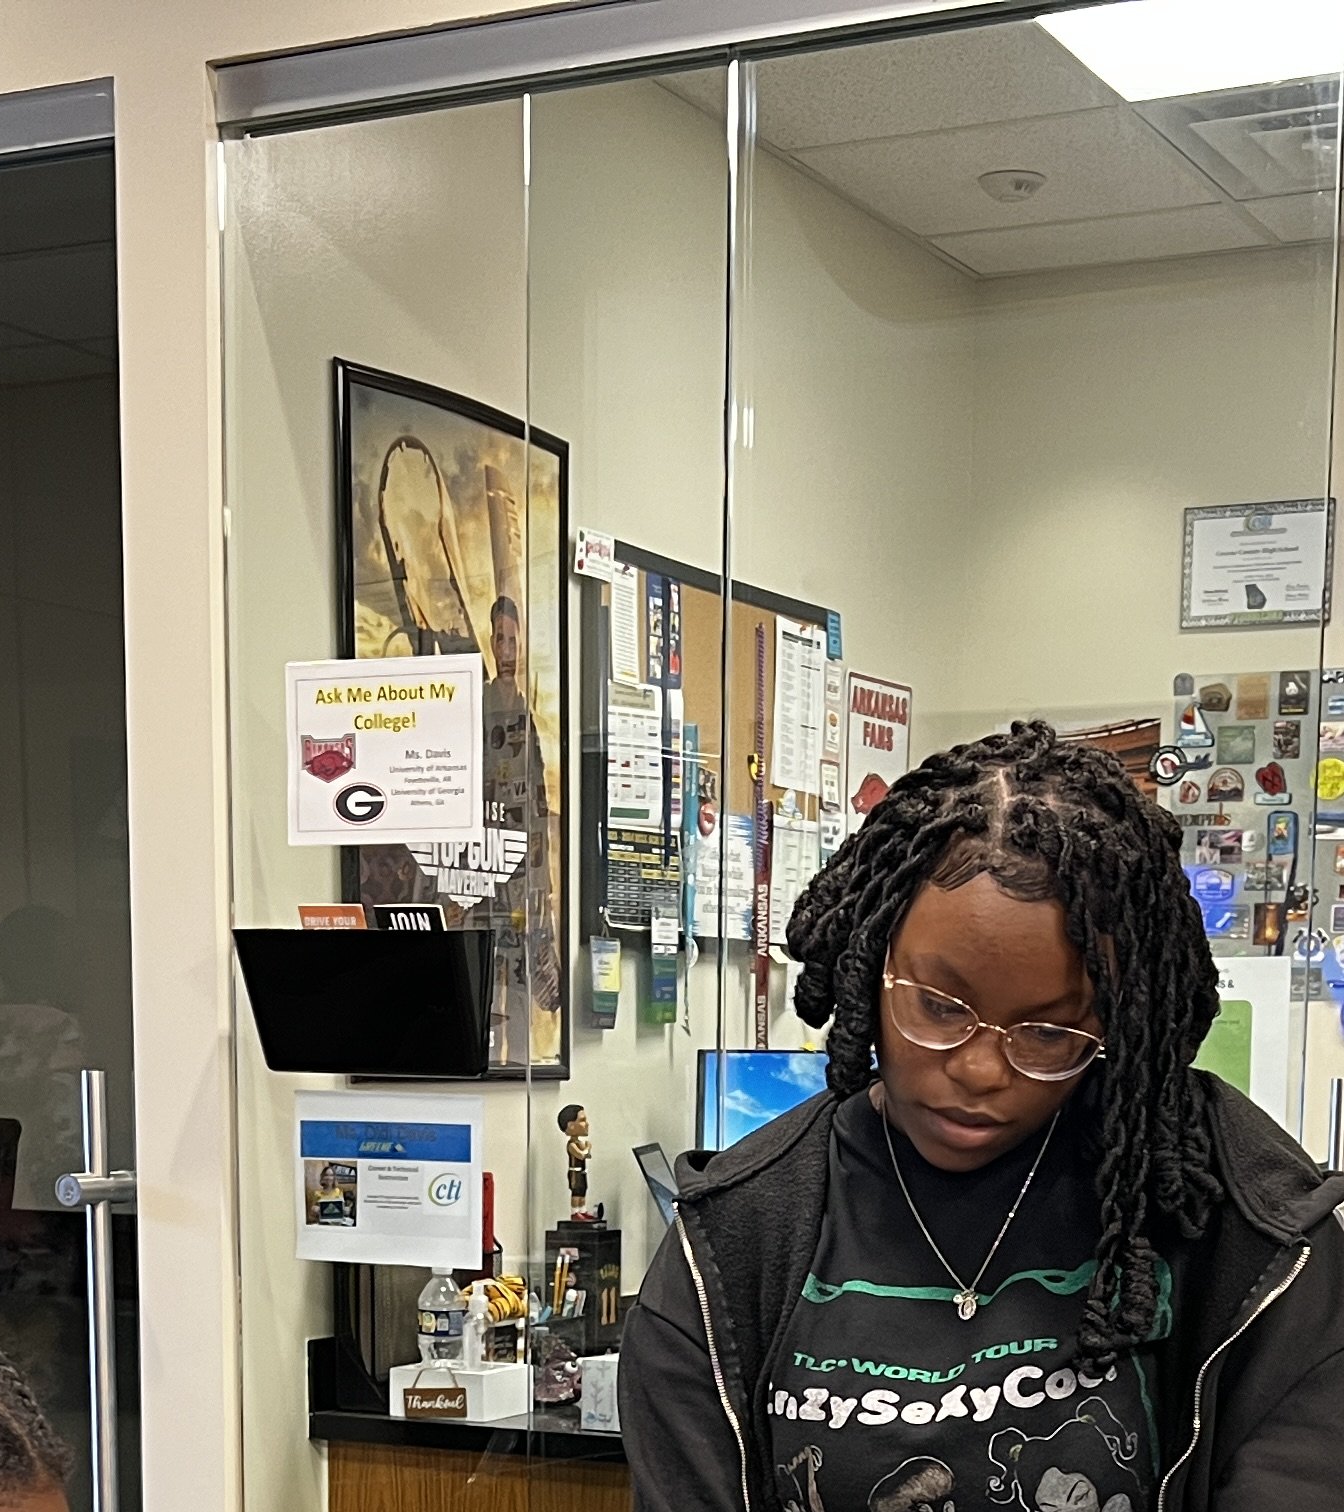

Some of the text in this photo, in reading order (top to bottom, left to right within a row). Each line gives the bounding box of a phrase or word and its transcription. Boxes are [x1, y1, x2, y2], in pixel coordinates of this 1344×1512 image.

[316, 683, 455, 704] Ask Me About My
[851, 685, 907, 725] ARKANSAS
[354, 712, 416, 732] College!
[485, 801, 506, 822] ISE
[437, 868, 496, 898] MAVERICK
[388, 912, 431, 931] JOIN
[757, 884, 768, 957] ARKANSAS
[851, 1357, 966, 1384] WORLD
[971, 1337, 1059, 1364] TOUR
[405, 1394, 465, 1410] Thankful
